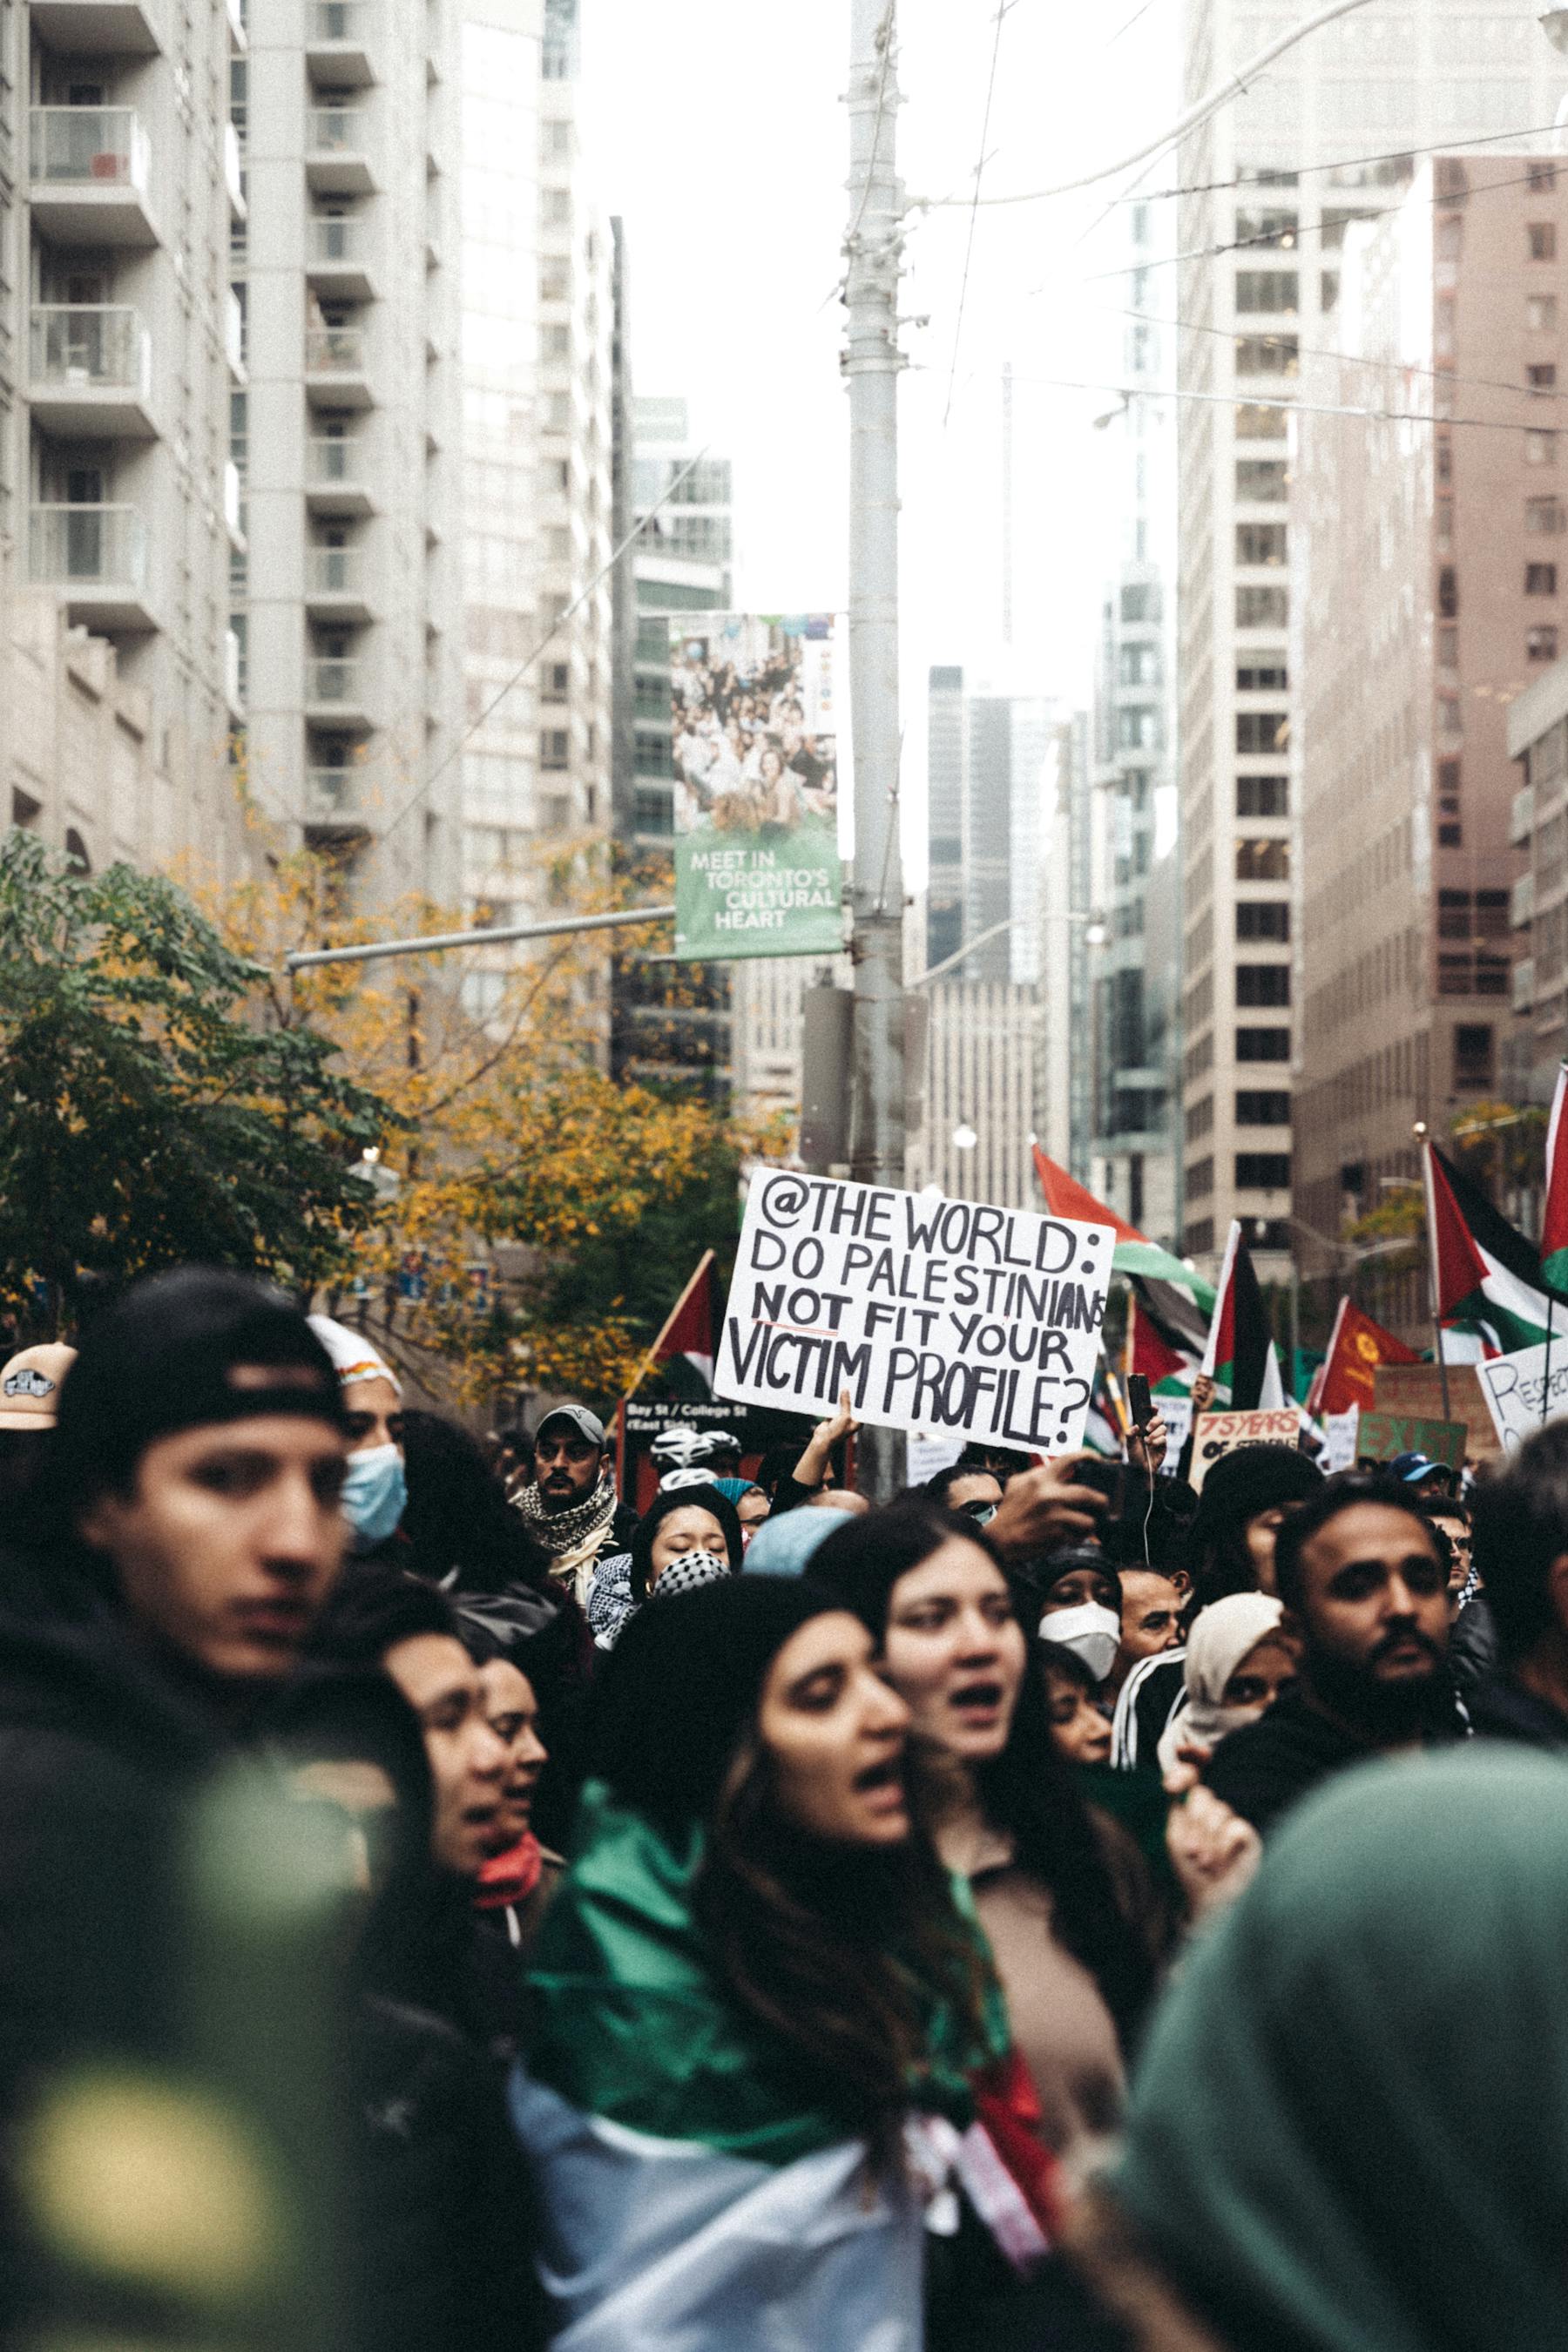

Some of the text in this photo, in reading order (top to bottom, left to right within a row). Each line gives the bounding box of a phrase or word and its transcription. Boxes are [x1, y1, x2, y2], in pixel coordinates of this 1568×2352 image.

[691, 850, 776, 870] MEET IN
[706, 868, 829, 889] TORONTO'S
[726, 889, 837, 909] CULTURAL
[714, 909, 787, 929] HEART
[761, 1175, 1099, 1274] @THE WORLD:
[751, 1228, 1105, 1334] DO PALESTINIANS
[753, 1282, 1076, 1373] NOT FIT YOUR
[728, 1317, 1090, 1446] VICTIM PROFILE?
[626, 1403, 652, 1417] Bay
[654, 1403, 668, 1416] St
[681, 1403, 731, 1418] College
[733, 1405, 747, 1416] St
[1359, 1413, 1465, 1470] EXIST
